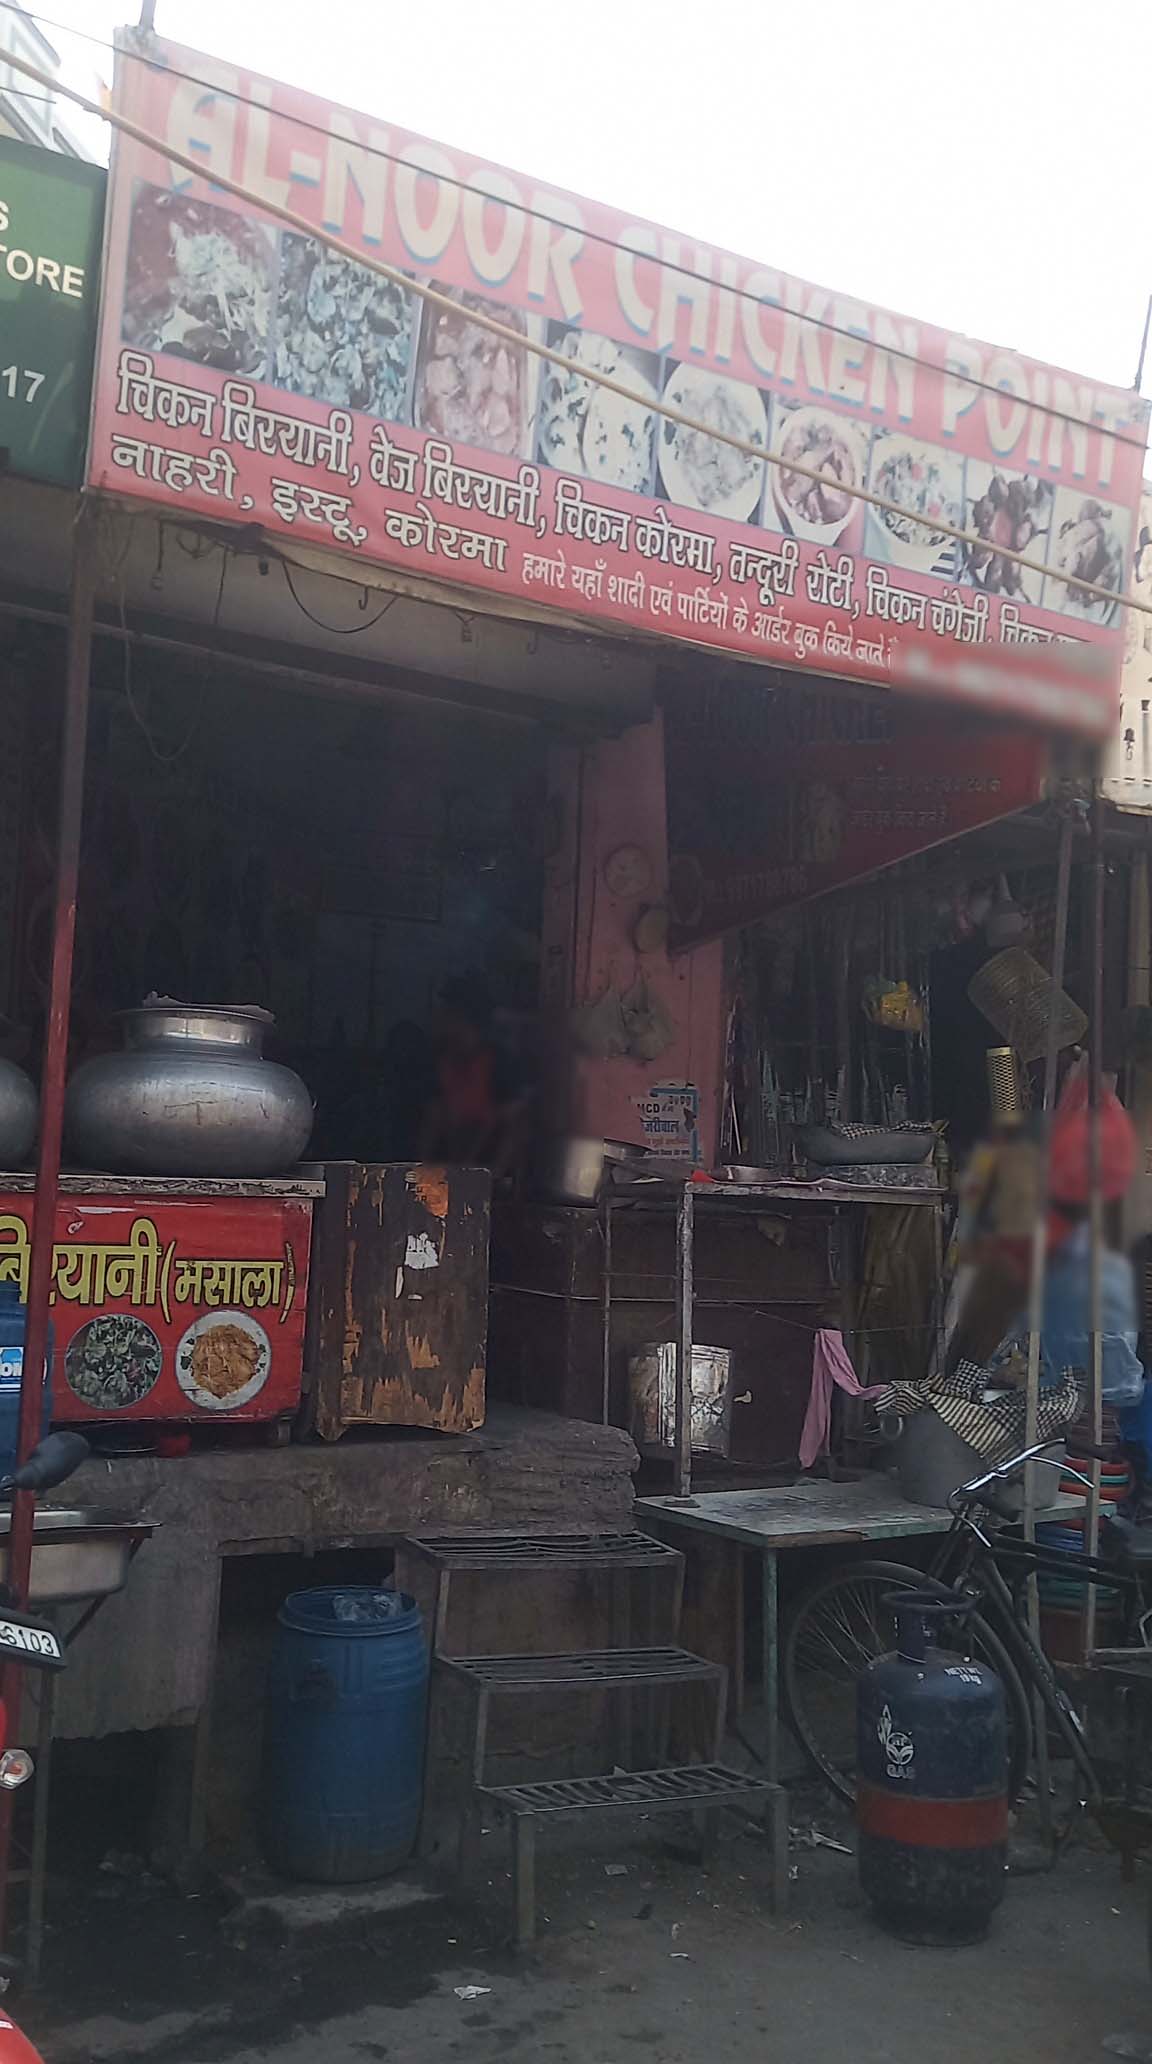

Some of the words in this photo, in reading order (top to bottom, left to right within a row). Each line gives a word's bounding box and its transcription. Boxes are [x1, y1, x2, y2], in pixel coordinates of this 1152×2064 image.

[0, 243, 84, 299] ORE
[165, 64, 585, 326] AL-NOOR
[613, 226, 918, 425] CHICKEN
[941, 338, 1131, 488] POINT
[116, 349, 216, 437] चिकन
[220, 380, 361, 487] बिरयानी,
[369, 424, 418, 493] वेज
[423, 439, 547, 538] बिरयानी,
[553, 478, 632, 551] चिकन
[805, 551, 860, 620] रोटी,
[865, 565, 928, 629] चिकन
[384, 502, 508, 573] कोरमा
[522, 550, 567, 589] हमारे
[571, 558, 607, 600] यहाँ
[608, 571, 645, 609] शादी
[650, 581, 674, 615] एवं
[732, 597, 749, 633] के
[0, 1217, 162, 1307] बियानी
[0, 1625, 54, 1655] 6103
